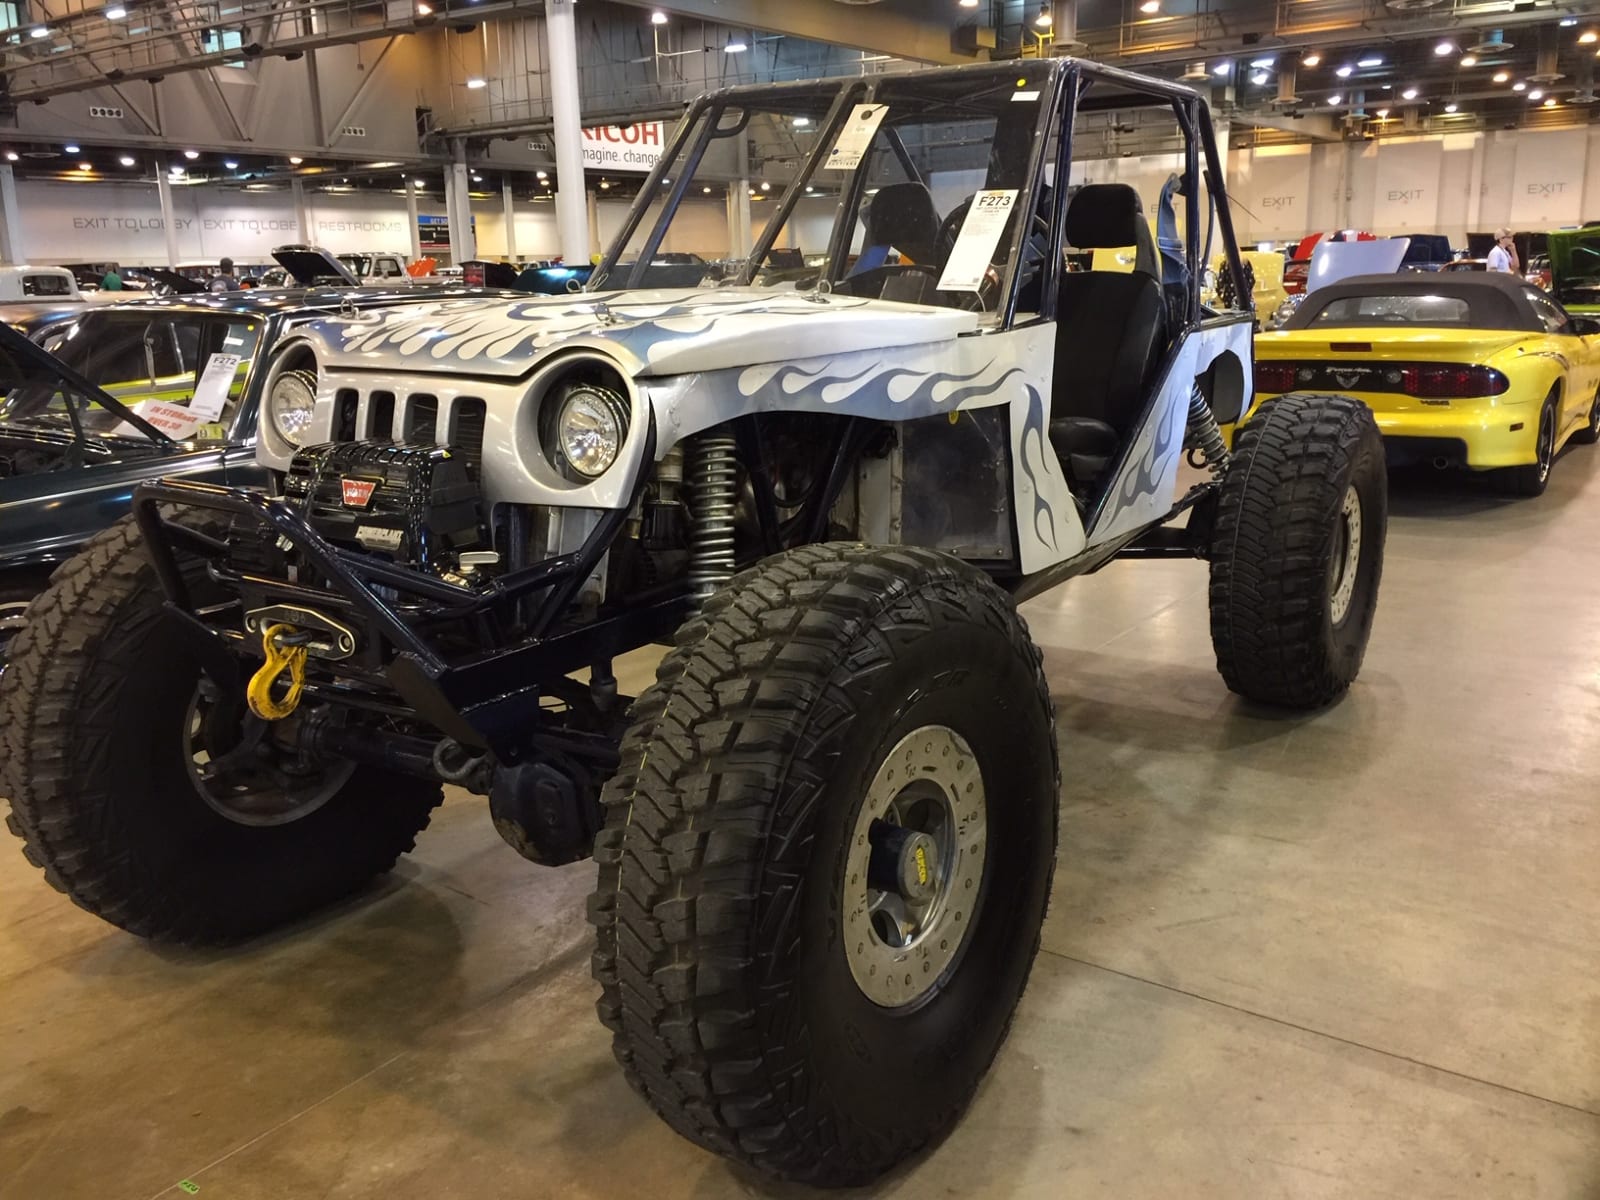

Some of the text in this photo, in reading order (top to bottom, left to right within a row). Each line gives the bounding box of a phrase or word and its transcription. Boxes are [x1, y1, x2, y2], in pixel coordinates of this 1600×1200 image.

[582, 147, 621, 164] magine.
[1527, 182, 1566, 194] EXIT
[1388, 189, 1424, 200] EXIT
[979, 196, 1011, 207] F273
[1262, 196, 1295, 207] EXIT
[73, 218, 192, 229] EXIT TO LOBY
[203, 219, 235, 230] EXIT
[240, 219, 260, 230] TO
[319, 220, 402, 232] RESTROOMS
